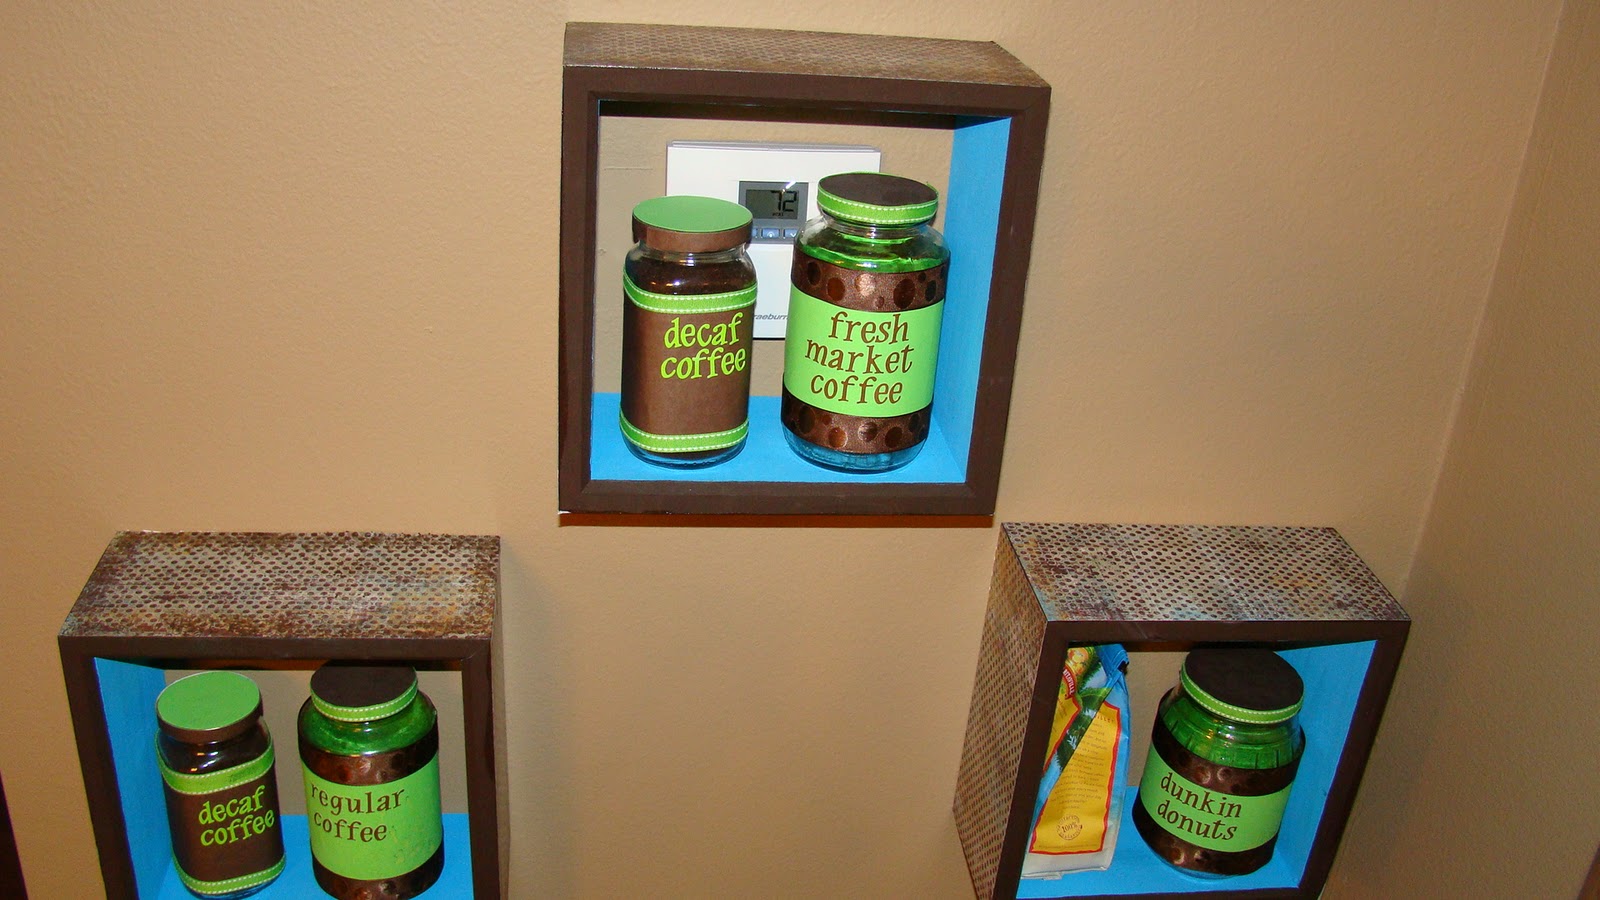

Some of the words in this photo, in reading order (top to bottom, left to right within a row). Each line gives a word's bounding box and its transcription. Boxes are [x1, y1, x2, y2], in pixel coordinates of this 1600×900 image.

[770, 190, 797, 211] 72
[664, 312, 743, 348] decaf
[828, 311, 909, 345] fresh
[660, 347, 746, 380] coffee
[805, 338, 914, 375] market
[810, 374, 903, 404] coffee
[198, 785, 265, 825] decaf
[310, 783, 405, 816] regular
[1160, 772, 1242, 818] dunkin
[200, 809, 275, 846] coffee
[313, 811, 388, 843] coffee
[1157, 800, 1238, 842] donuts
